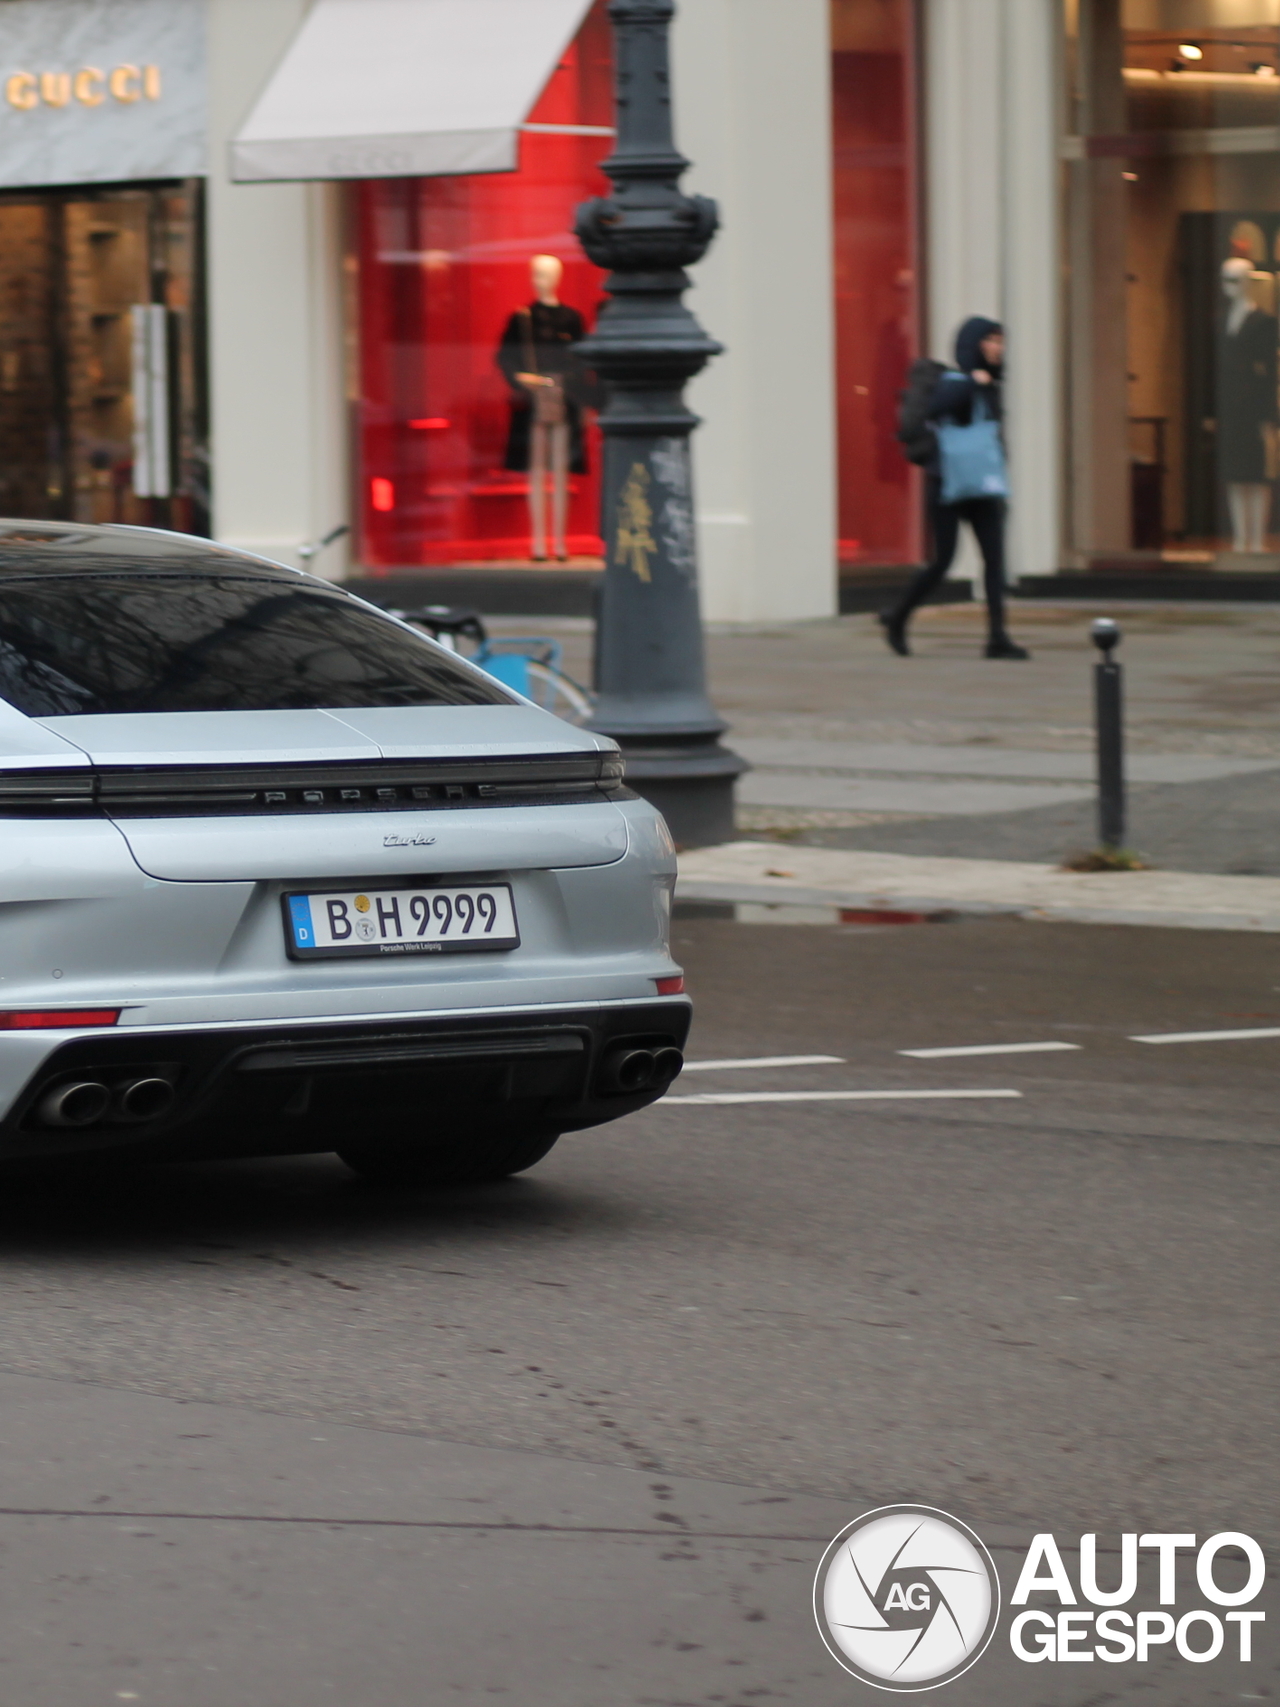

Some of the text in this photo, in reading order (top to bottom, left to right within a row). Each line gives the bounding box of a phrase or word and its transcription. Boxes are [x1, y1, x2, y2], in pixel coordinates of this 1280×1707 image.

[6, 64, 161, 109] GUCCI
[264, 783, 497, 803] PORSCHE
[326, 893, 497, 940] B H 9999
[299, 928, 308, 940] D
[380, 944, 404, 952] Porsche
